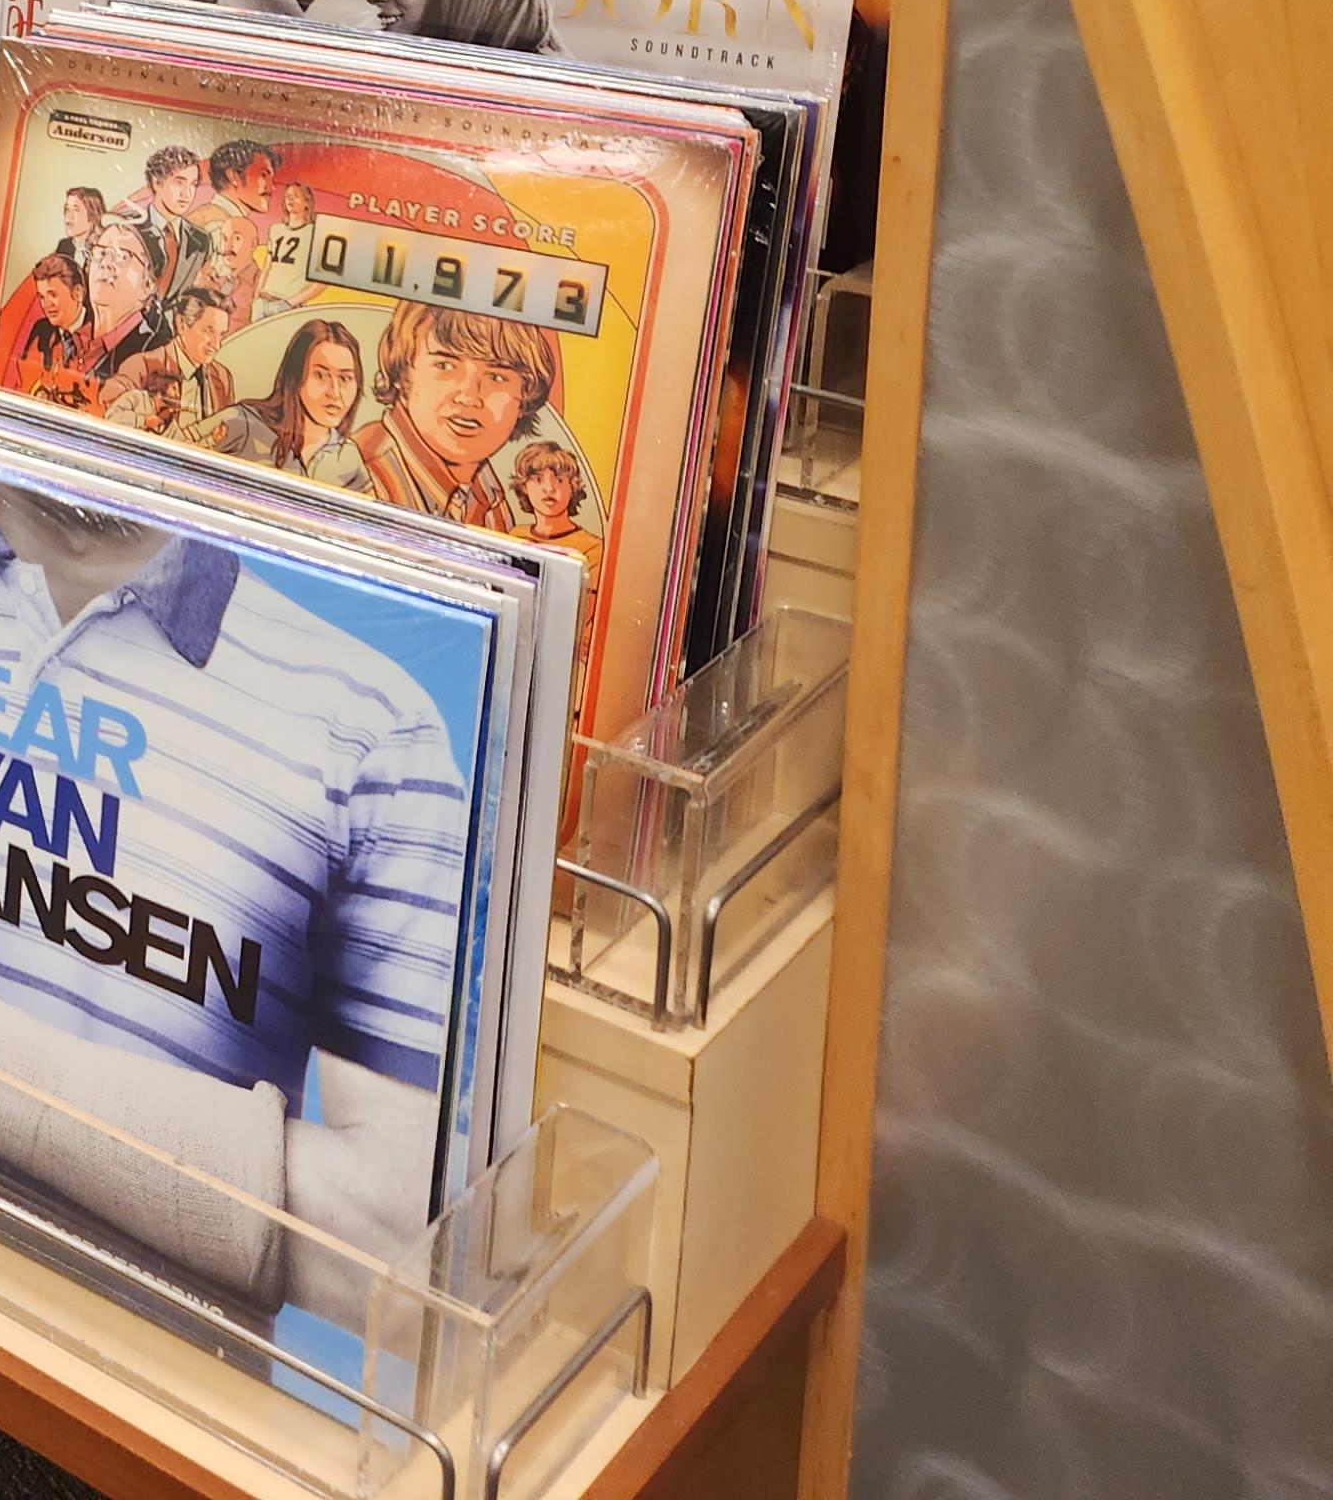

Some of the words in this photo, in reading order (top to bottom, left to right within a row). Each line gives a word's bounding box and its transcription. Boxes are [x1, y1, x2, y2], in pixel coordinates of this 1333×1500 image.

[629, 35, 777, 71] SOUNDTRACK
[68, 60, 181, 87] ORIGINAL
[199, 77, 290, 103] MOTION
[309, 96, 422, 125] PICTURE
[51, 123, 126, 148] Anderson
[347, 191, 461, 229] PLAYER
[471, 213, 577, 248] SCORE
[270, 235, 301, 267] 12
